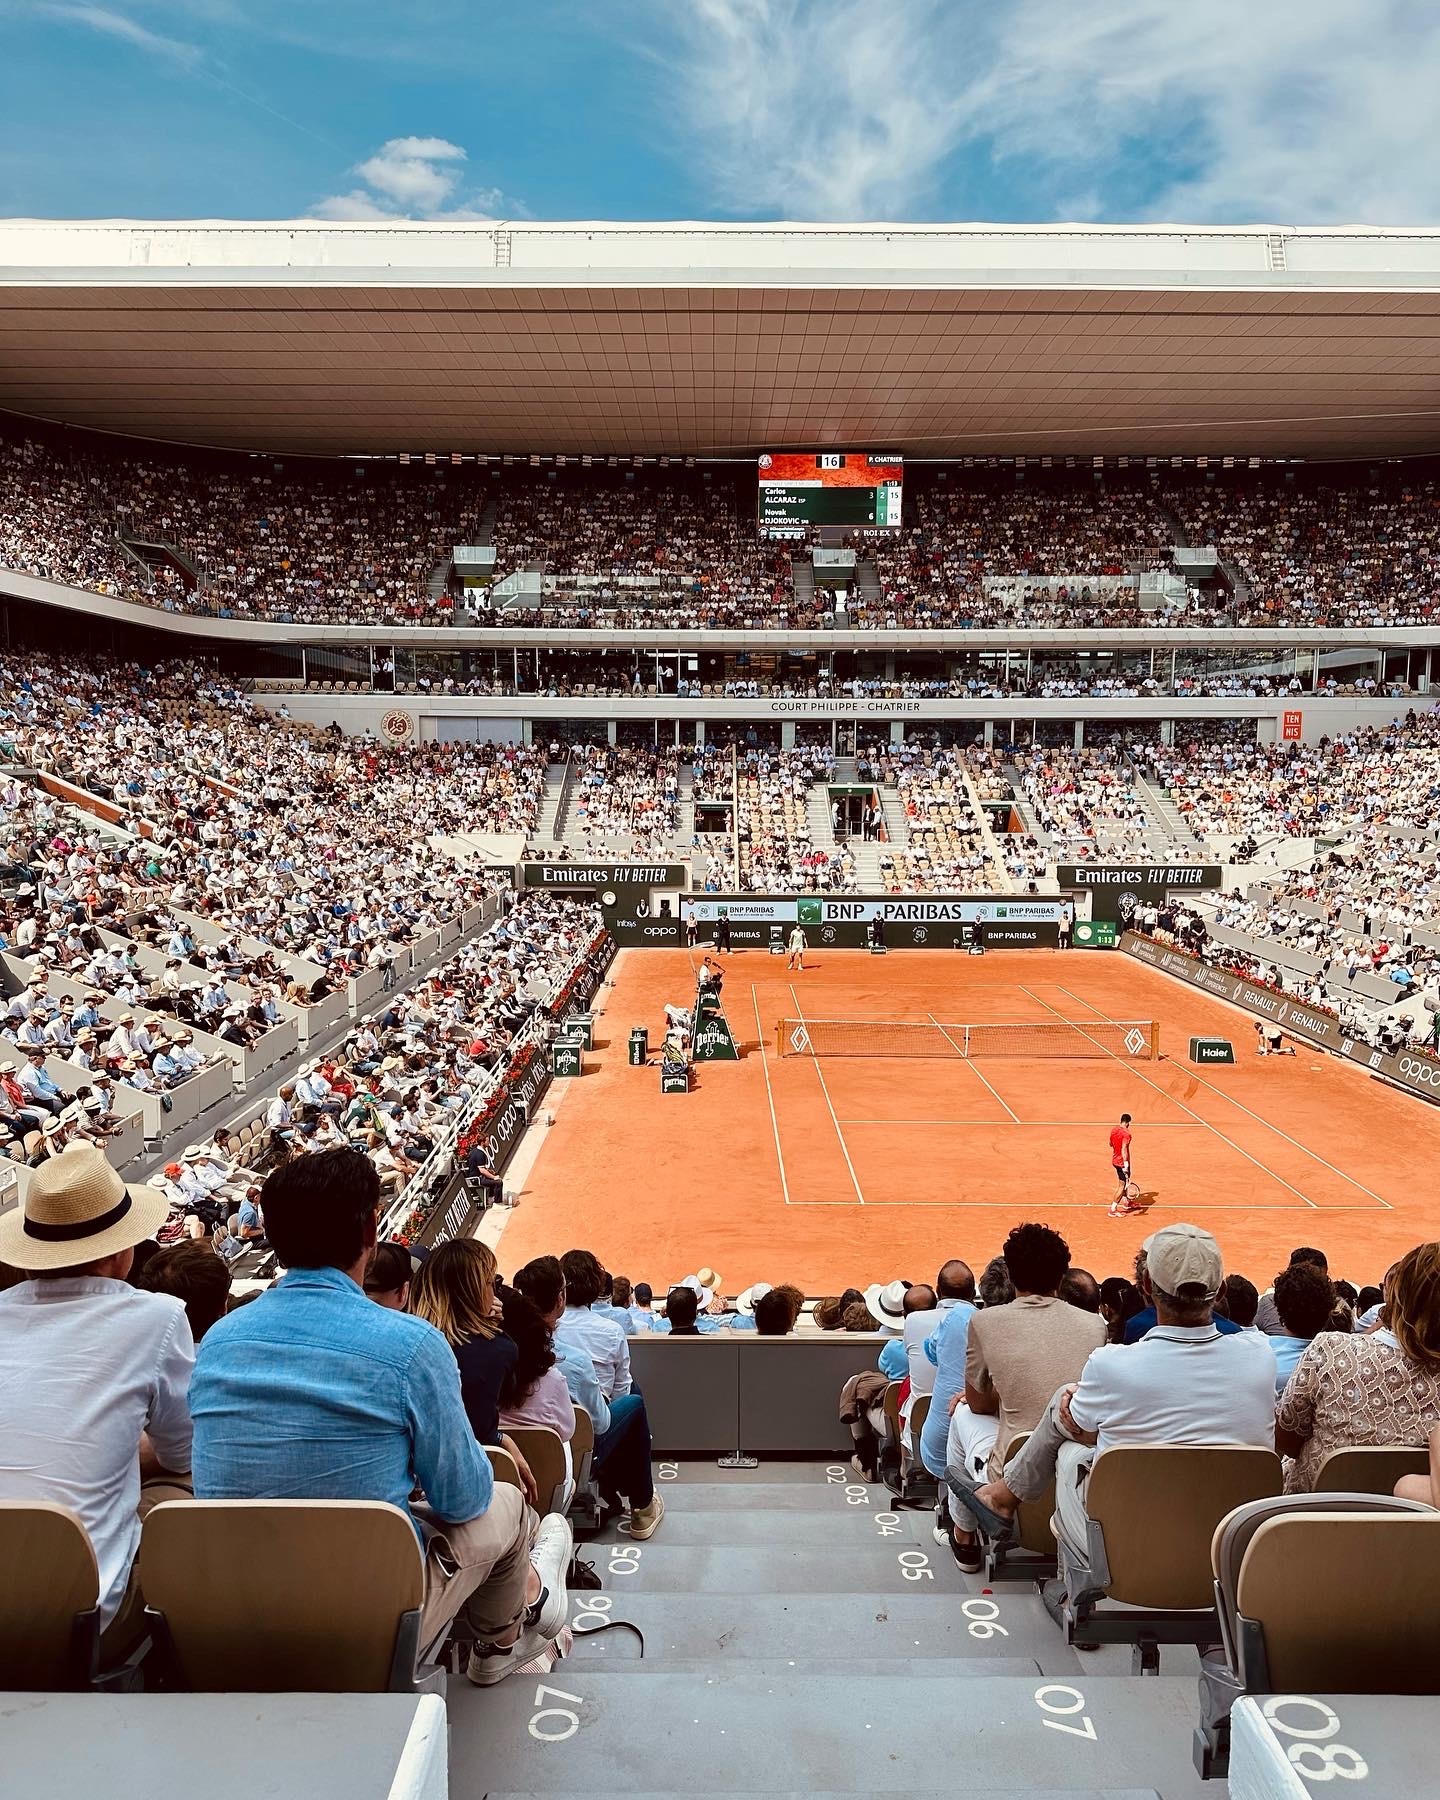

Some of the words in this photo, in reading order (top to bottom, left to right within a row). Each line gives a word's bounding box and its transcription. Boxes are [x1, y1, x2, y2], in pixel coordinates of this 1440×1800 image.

[824, 456, 838, 467] 16
[765, 487, 786, 495] Carlos
[869, 491, 874, 499] 3
[879, 491, 885, 499] 2
[890, 491, 899, 499] 15
[765, 508, 787, 516] Novak
[868, 512, 874, 521] 6
[890, 512, 899, 520] 15
[765, 517, 800, 525] DJOKOVIC
[771, 702, 808, 711] COURT
[811, 702, 858, 711] PHILIPPE
[867, 702, 920, 711] CHATRIER
[1286, 714, 1300, 724] TEN
[1285, 727, 1299, 737] NIS
[543, 867, 608, 882] Emirates
[613, 868, 630, 882] FLY
[631, 868, 667, 882] BETTER
[1075, 868, 1142, 883] Emirates
[1147, 869, 1166, 883] FLY
[1166, 869, 1203, 883] BETTER
[827, 904, 865, 919] BNP
[884, 904, 961, 919] PARIBAS
[643, 927, 677, 936] oppo
[1097, 935, 1113, 944] 1:13
[1243, 990, 1277, 1012] RENAULT
[1290, 1011, 1330, 1036] RENAULT
[1202, 1048, 1228, 1057] Haier
[497, 1104, 517, 1141] oppo
[658, 1462, 679, 1480] 02
[826, 1465, 847, 1484] 02
[844, 1485, 870, 1505] 03
[874, 1512, 903, 1537] 04
[608, 1546, 642, 1575] 05
[897, 1551, 935, 1581] 05
[572, 1595, 613, 1632] 06
[961, 1598, 1009, 1639] 06
[528, 1684, 583, 1741] 07
[1034, 1684, 1098, 1741] 07
[1263, 1695, 1369, 1781] 08
